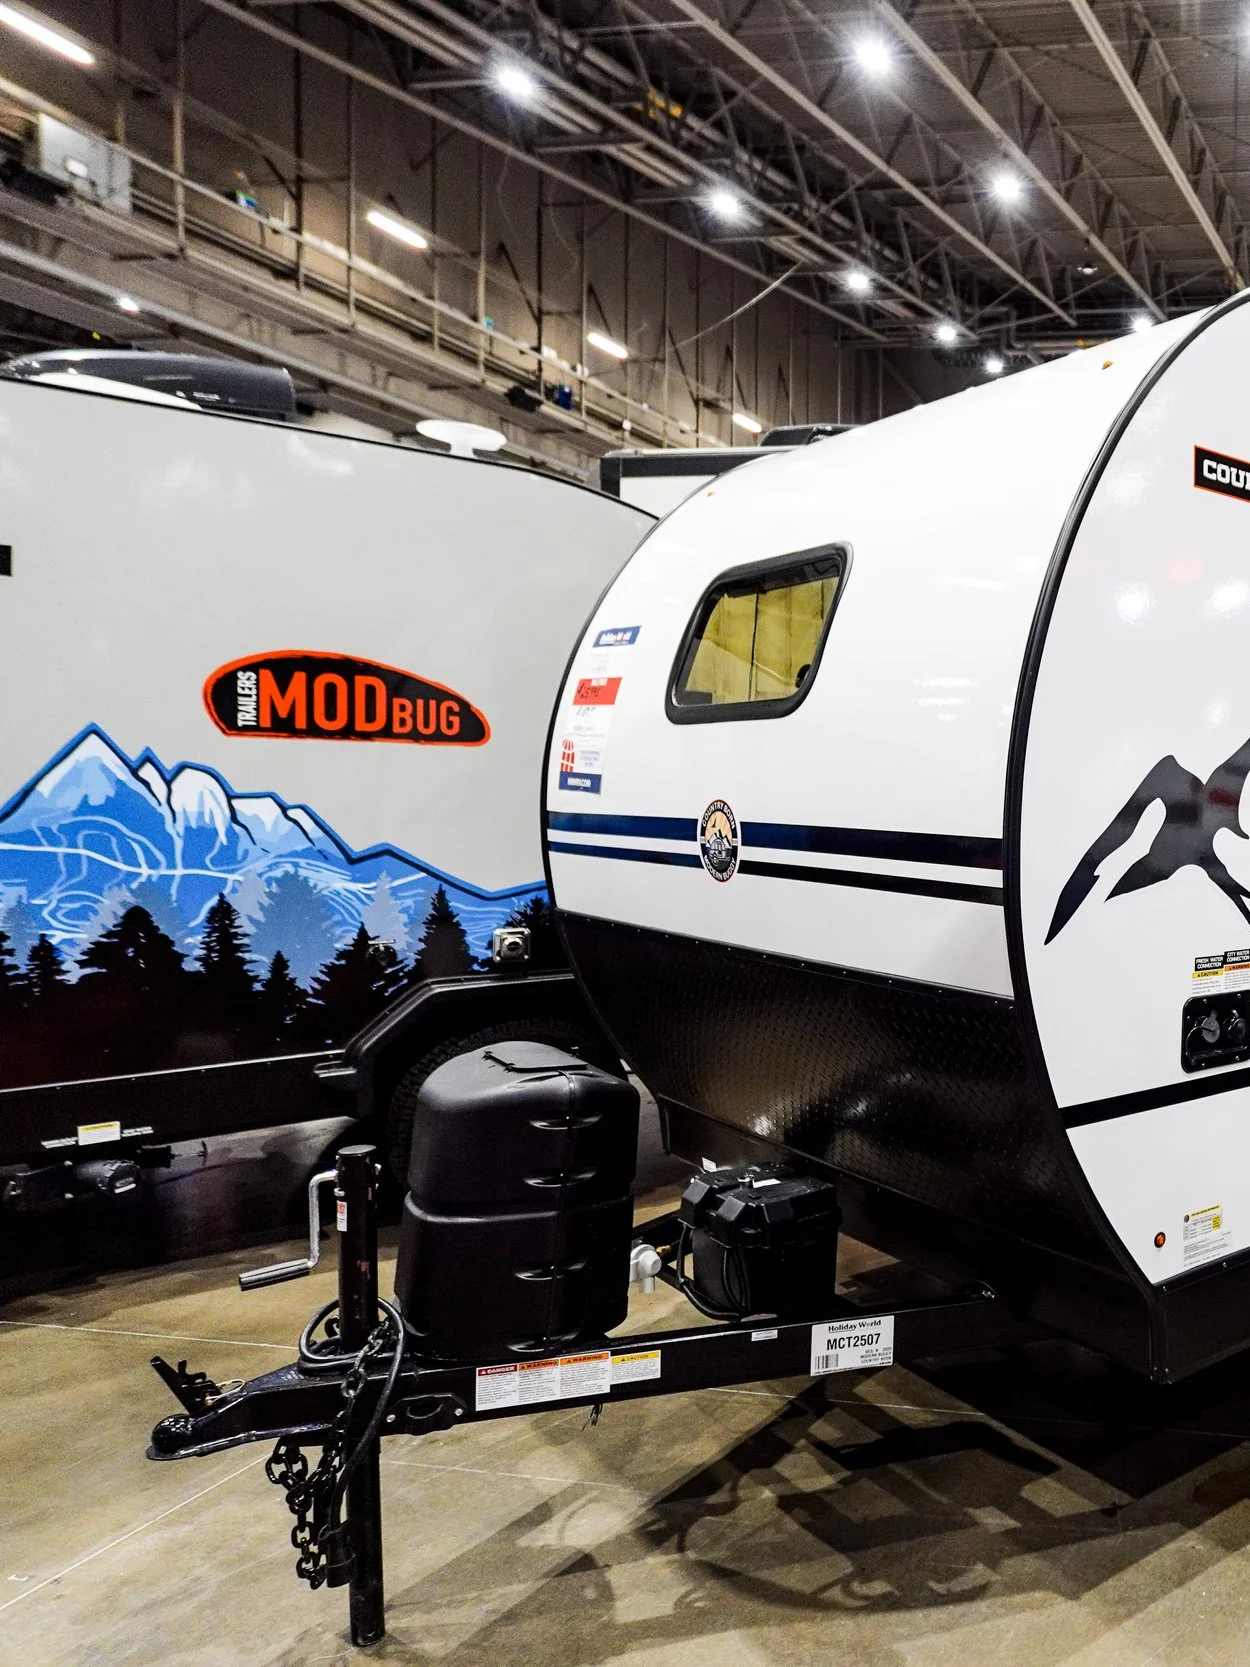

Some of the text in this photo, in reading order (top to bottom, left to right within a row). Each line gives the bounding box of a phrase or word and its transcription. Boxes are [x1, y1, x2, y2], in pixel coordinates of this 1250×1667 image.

[237, 670, 258, 727] TRAILERS
[702, 801, 736, 830] COUNTRY BORN
[703, 854, 736, 881] MODERN BUGGY
[828, 1320, 882, 1333] Holiday World
[826, 1333, 881, 1351] MCT2507
[526, 1360, 558, 1369] WARNING
[572, 1354, 603, 1363] WARNING
[487, 1365, 516, 1374] DANGER
